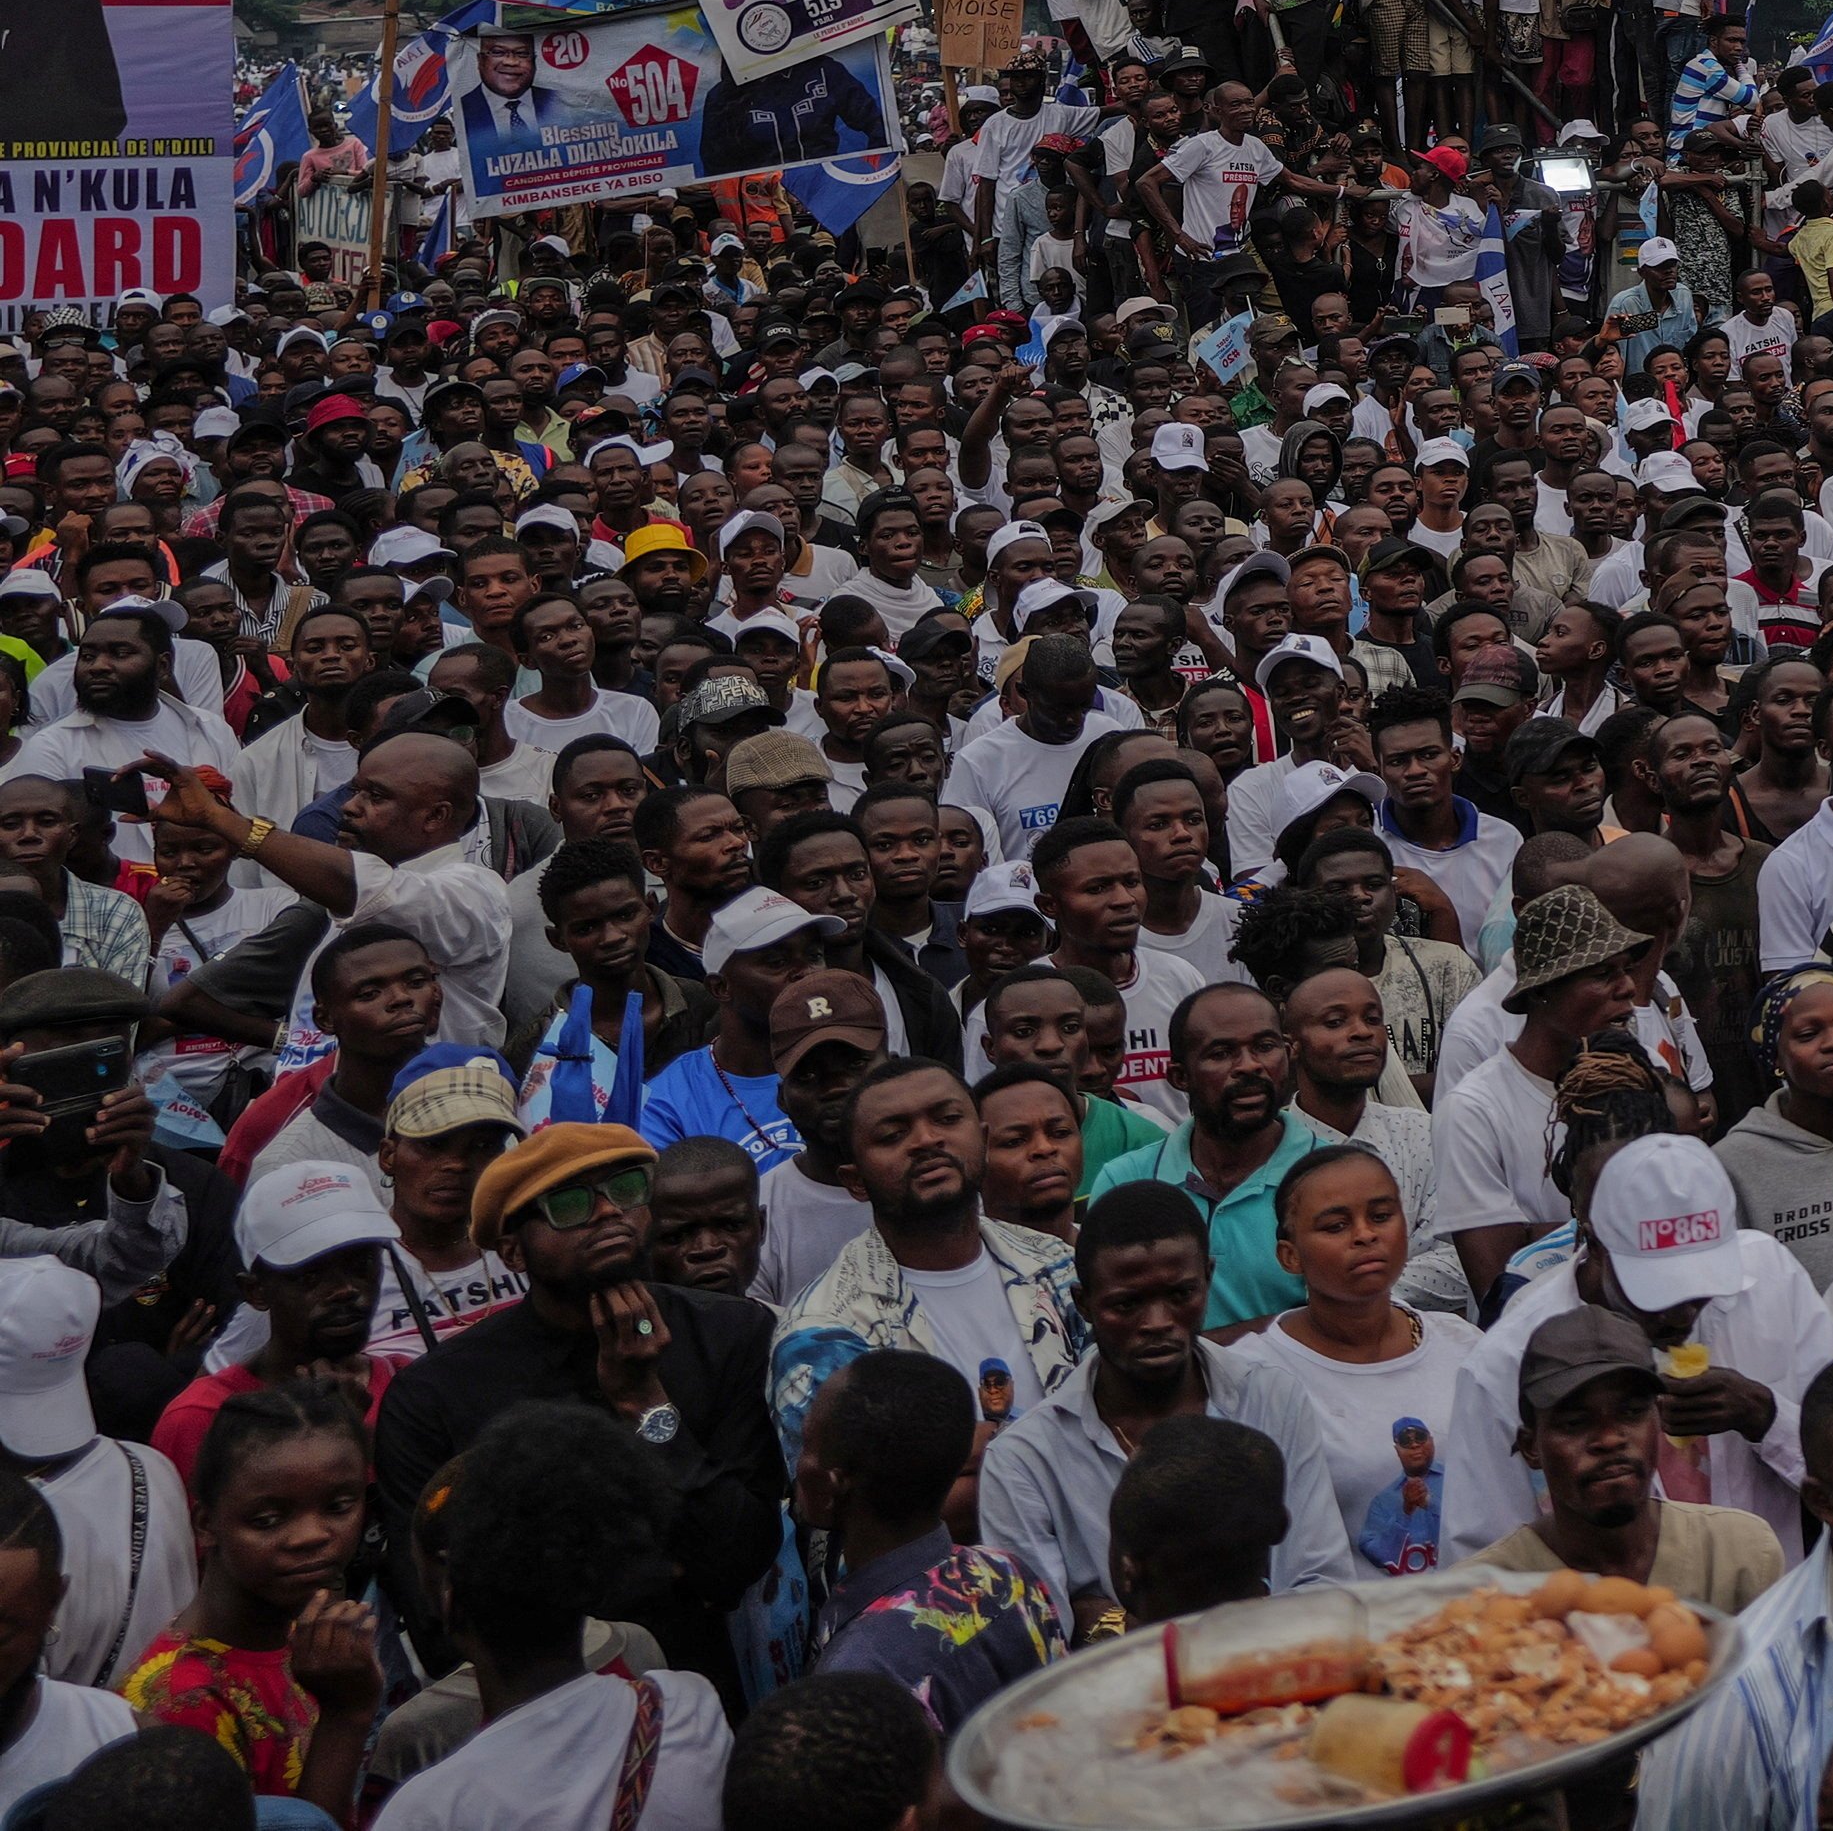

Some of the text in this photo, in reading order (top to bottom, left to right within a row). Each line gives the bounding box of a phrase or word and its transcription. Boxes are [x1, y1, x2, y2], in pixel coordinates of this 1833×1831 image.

[943, 21, 975, 37] OYO
[552, 31, 584, 66] 20
[626, 58, 688, 126] 504
[12, 138, 215, 158] PROVINCIAL DE N'DJILI
[540, 120, 620, 147] Blessing
[486, 129, 679, 178] LUZALA DIANSOKILA
[34, 167, 197, 213] N'KULA
[502, 173, 664, 207] KIMBANSEKE YA BISO
[1022, 808, 1058, 828] 769
[807, 997, 832, 1018] R
